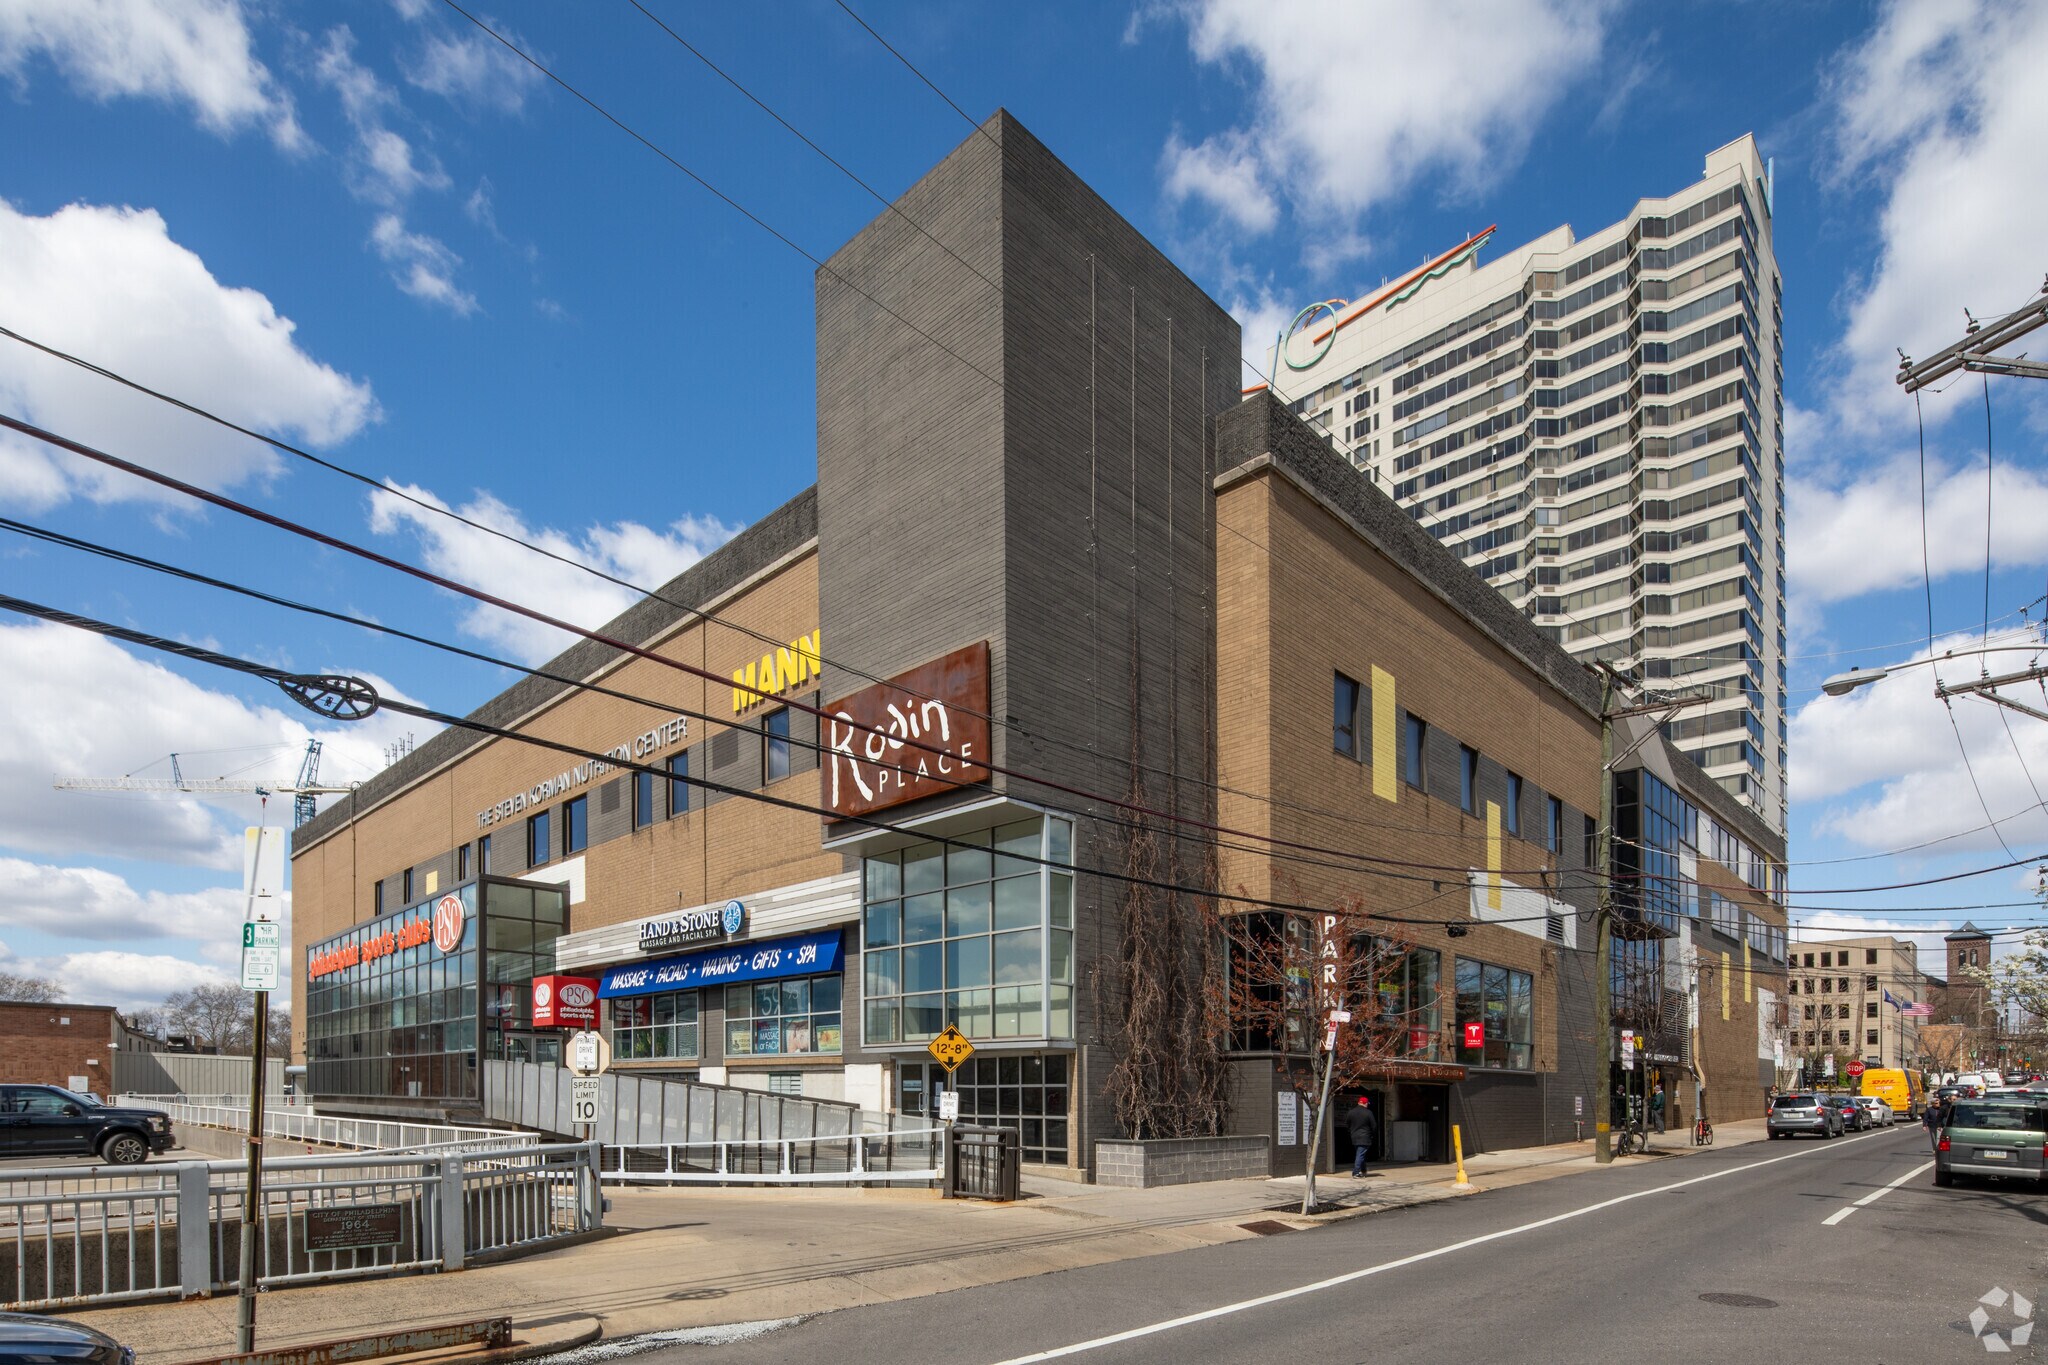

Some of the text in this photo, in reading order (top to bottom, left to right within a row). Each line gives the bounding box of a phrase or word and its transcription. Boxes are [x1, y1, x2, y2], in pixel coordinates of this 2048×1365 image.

[733, 628, 820, 712] MANN
[831, 700, 949, 808] Rodin
[477, 715, 688, 828] THE STEVEN KORMAN NUTRITION CENTER
[879, 743, 972, 793] PLACE
[263, 926, 272, 935] HR
[437, 901, 459, 946] PSC
[639, 911, 720, 940] HAND & STONE
[245, 926, 252, 944] 3
[255, 937, 278, 946] PARKING
[641, 929, 717, 948] MASSAGE AND FACIAL SPA
[309, 915, 431, 982] philadelphia sports clubs
[610, 943, 818, 990] MASSAGE FACIALS WAXING GIFTS SPA
[566, 986, 590, 1005] PSC
[760, 1031, 779, 1041] MASSAG
[766, 1041, 779, 1050] FACIA
[936, 1043, 968, 1054] 12'-8"
[573, 1081, 598, 1089] SPEED
[576, 1091, 595, 1099] LIMIT
[576, 1101, 595, 1119] 10
[312, 1211, 328, 1219] CITY
[345, 1208, 395, 1217] PHILADELPHIA
[341, 1220, 370, 1230] 1964
